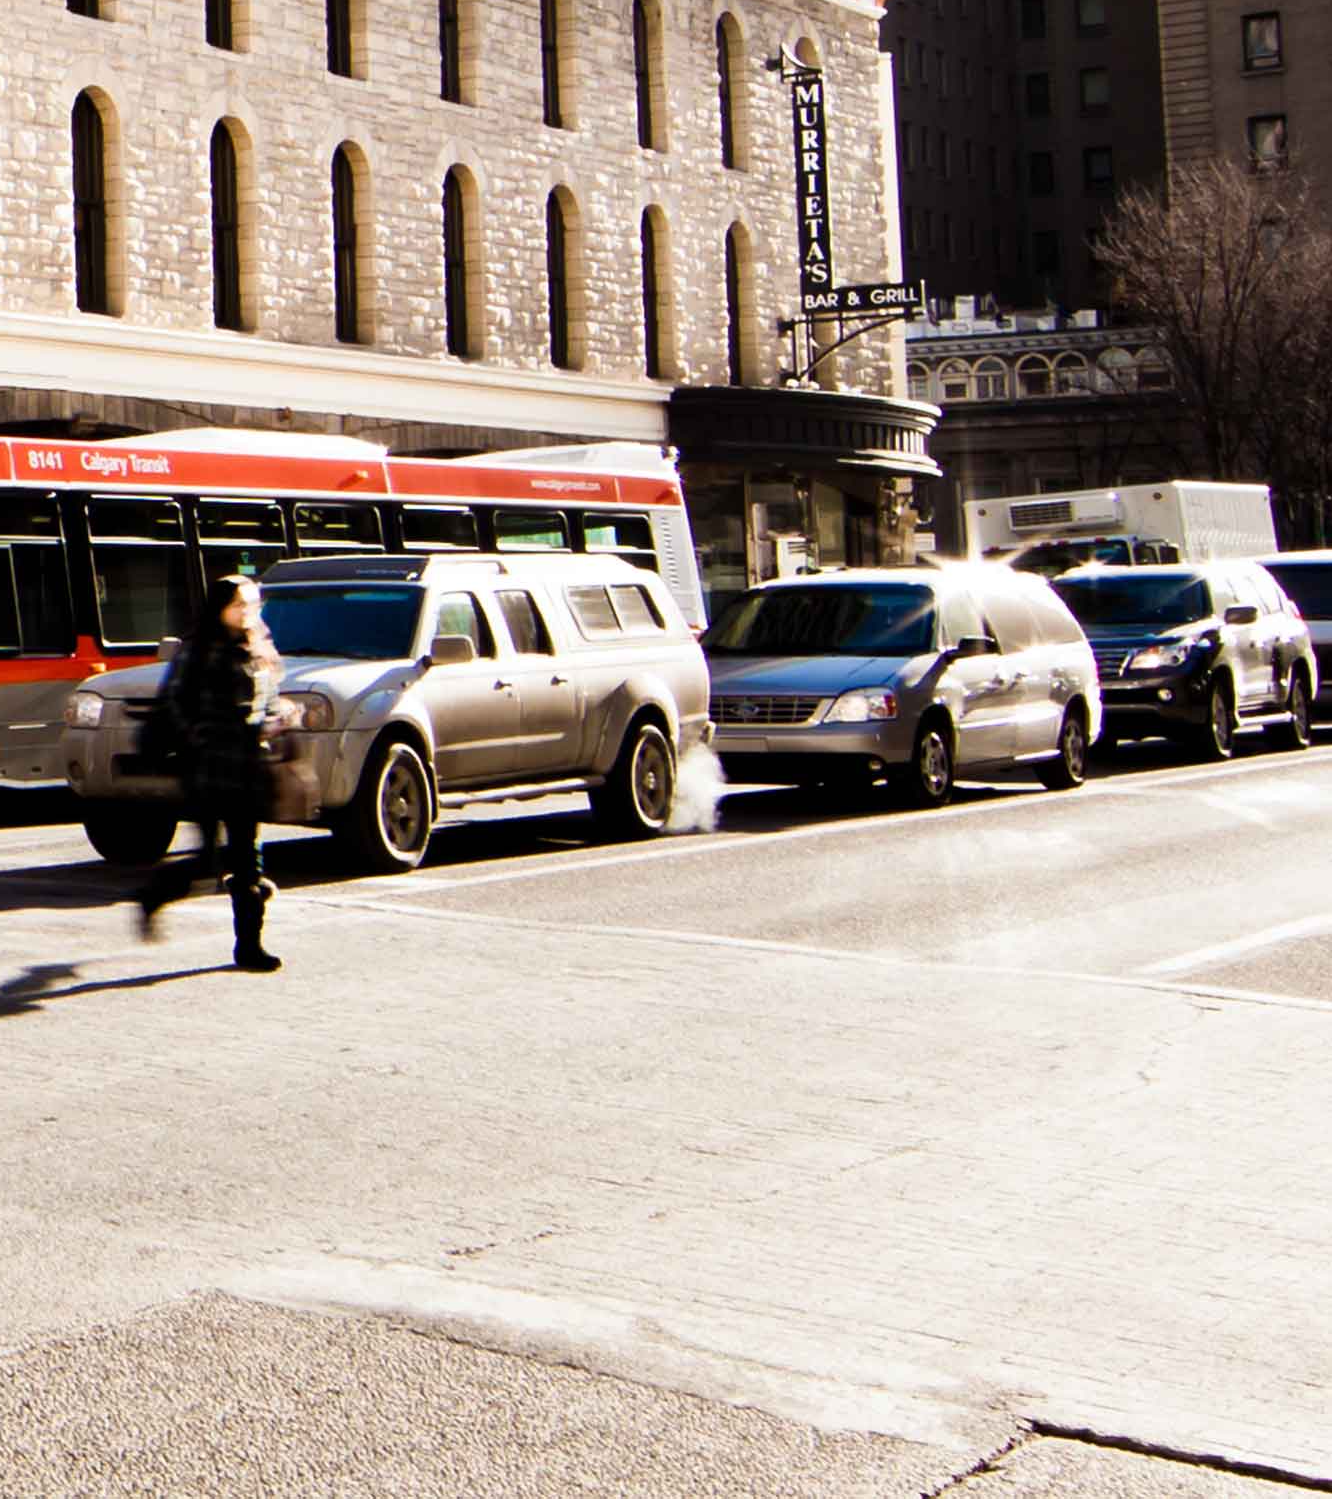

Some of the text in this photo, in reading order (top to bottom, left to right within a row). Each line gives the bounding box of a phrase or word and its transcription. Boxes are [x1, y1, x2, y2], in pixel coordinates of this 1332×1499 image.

[794, 83, 828, 283] MURRIETA'S
[804, 286, 919, 310] BAR & GRILL
[27, 450, 171, 477] 8141 Calgary Transit
